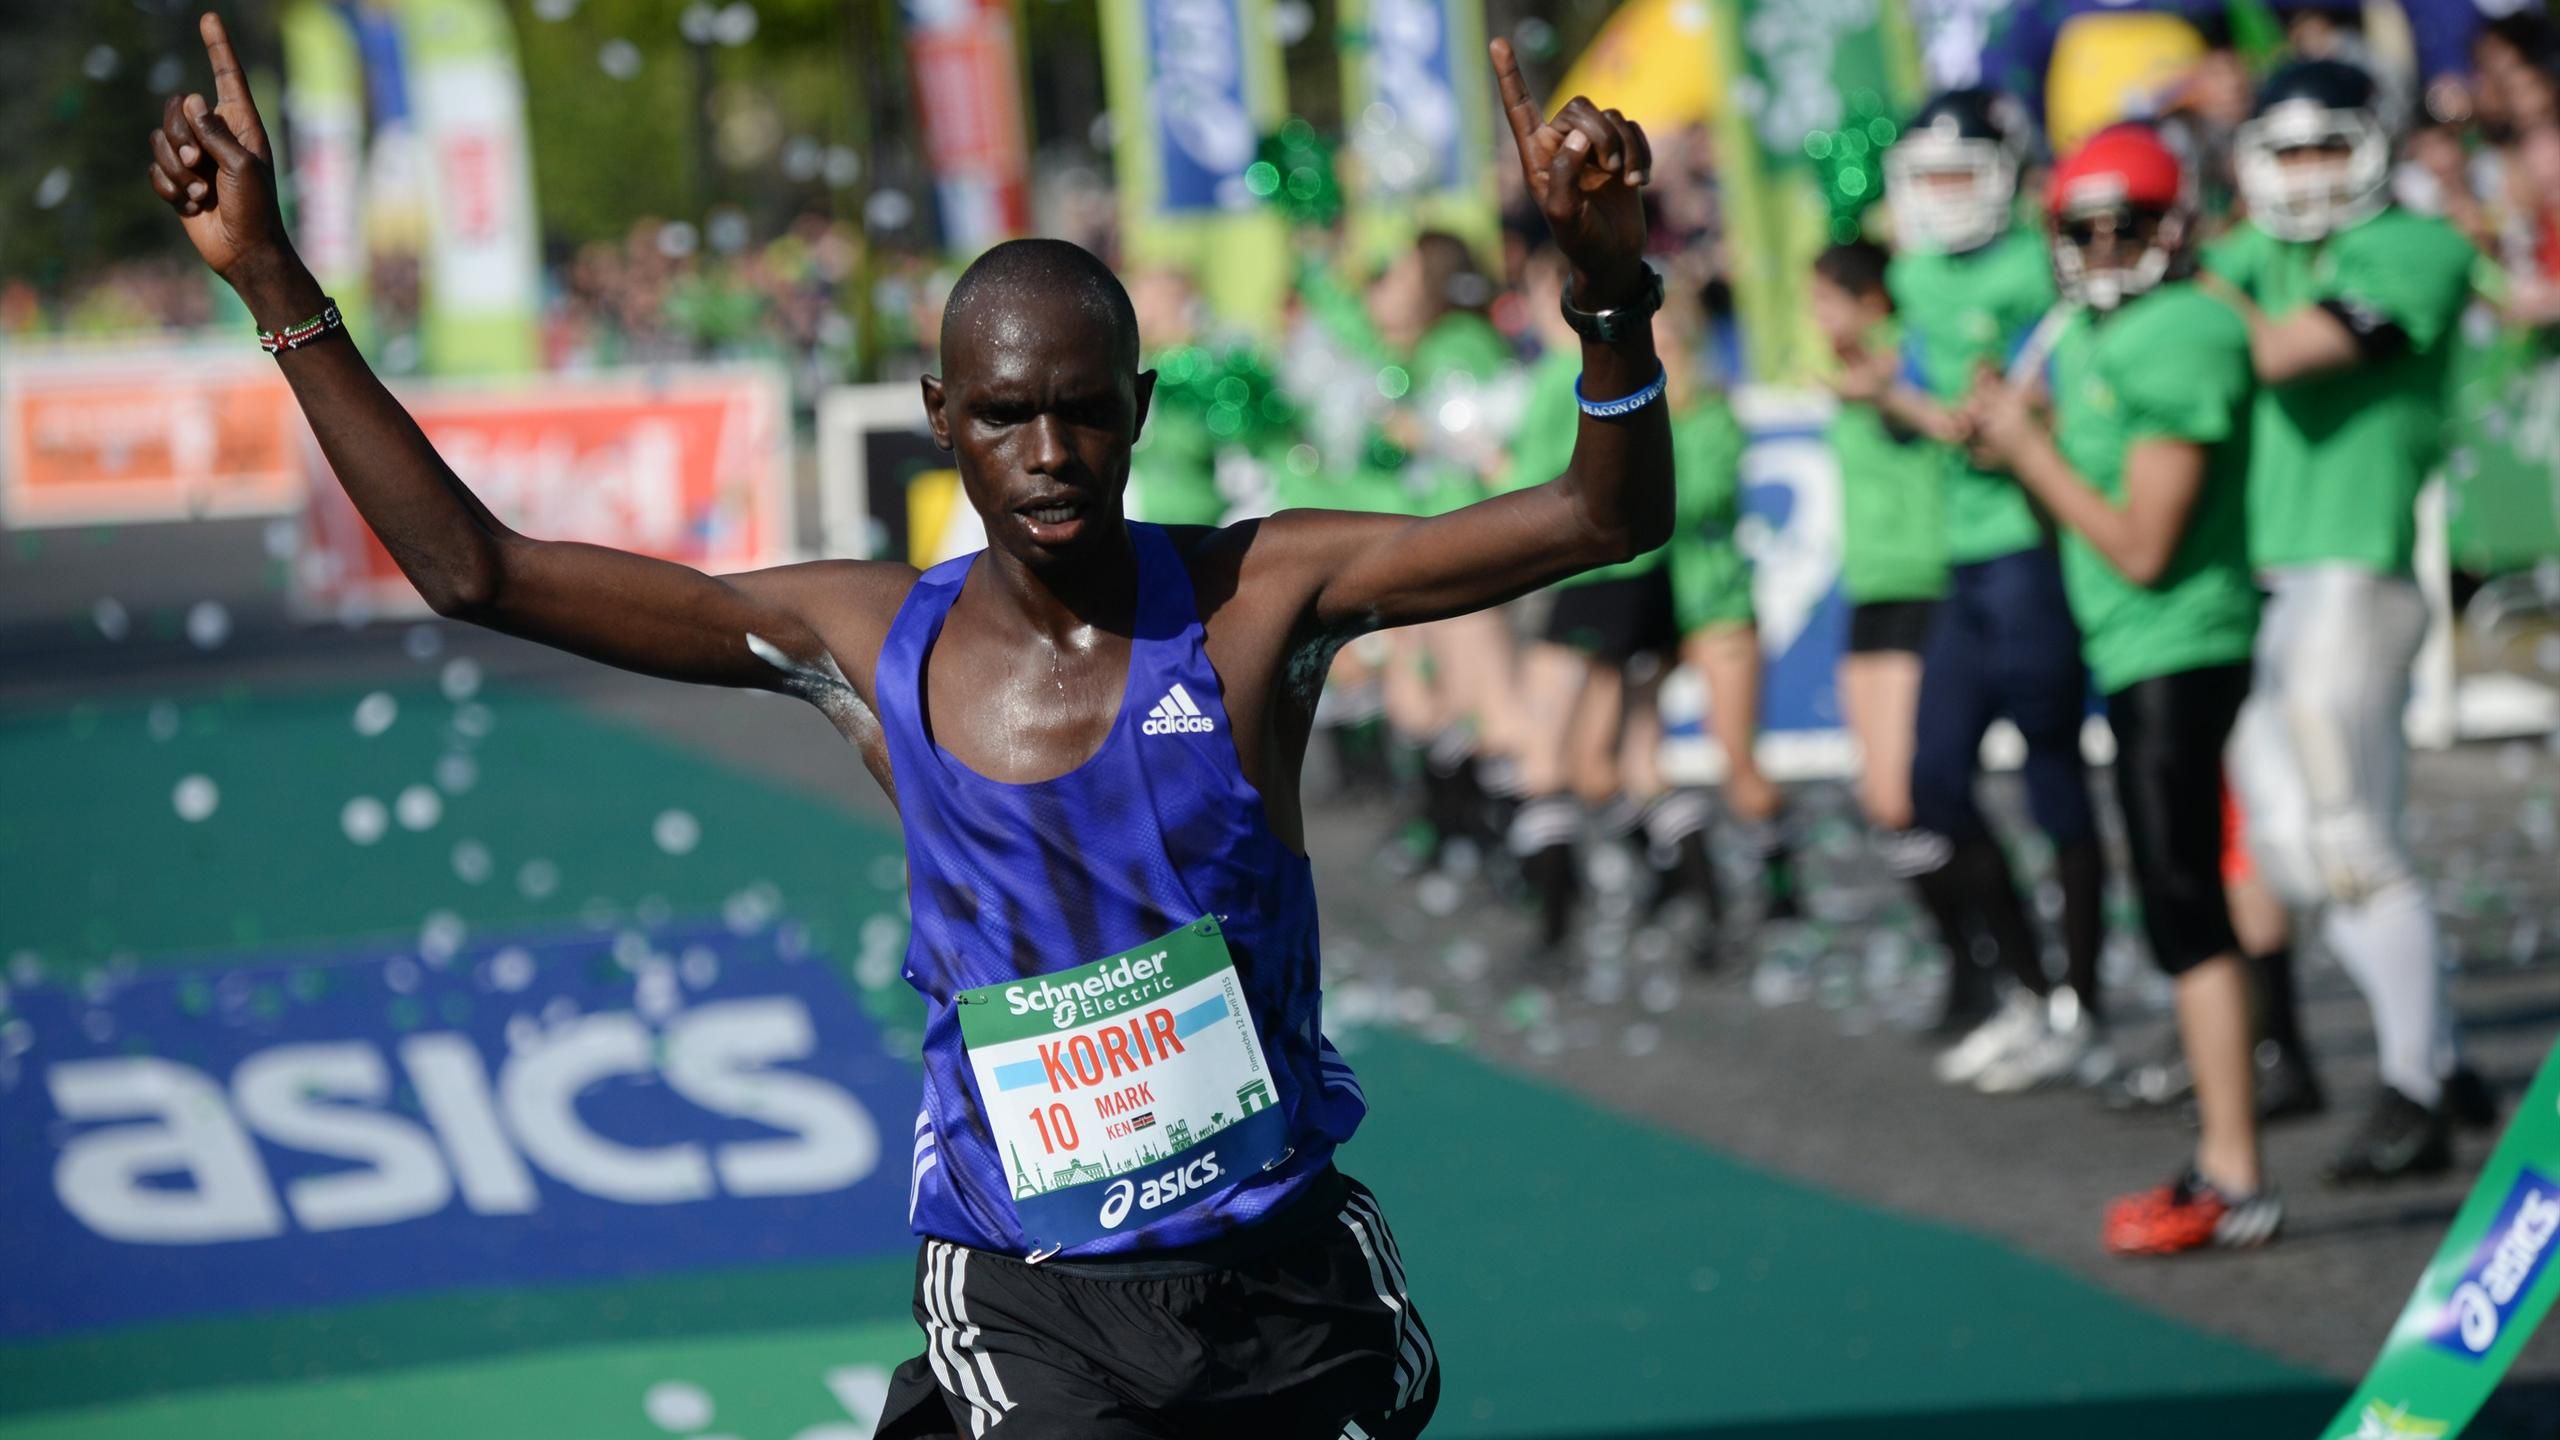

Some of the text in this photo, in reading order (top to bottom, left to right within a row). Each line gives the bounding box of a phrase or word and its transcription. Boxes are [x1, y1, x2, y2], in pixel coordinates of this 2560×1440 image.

[1581, 402, 1629, 416] BEACON
[1629, 394, 1646, 410] OF
[1142, 715, 1214, 735] adidas
[1005, 950, 1168, 1016] Schneider
[1080, 976, 1174, 1019] Electric
[1222, 976, 1236, 998] 2015
[1038, 1007, 1186, 1094] KORIR
[43, 995, 883, 1247] asics
[1094, 1081, 1156, 1120] MARK
[1029, 1102, 1080, 1155] 10
[1105, 1120, 1133, 1141] KEN
[1138, 1150, 1220, 1211] asics
